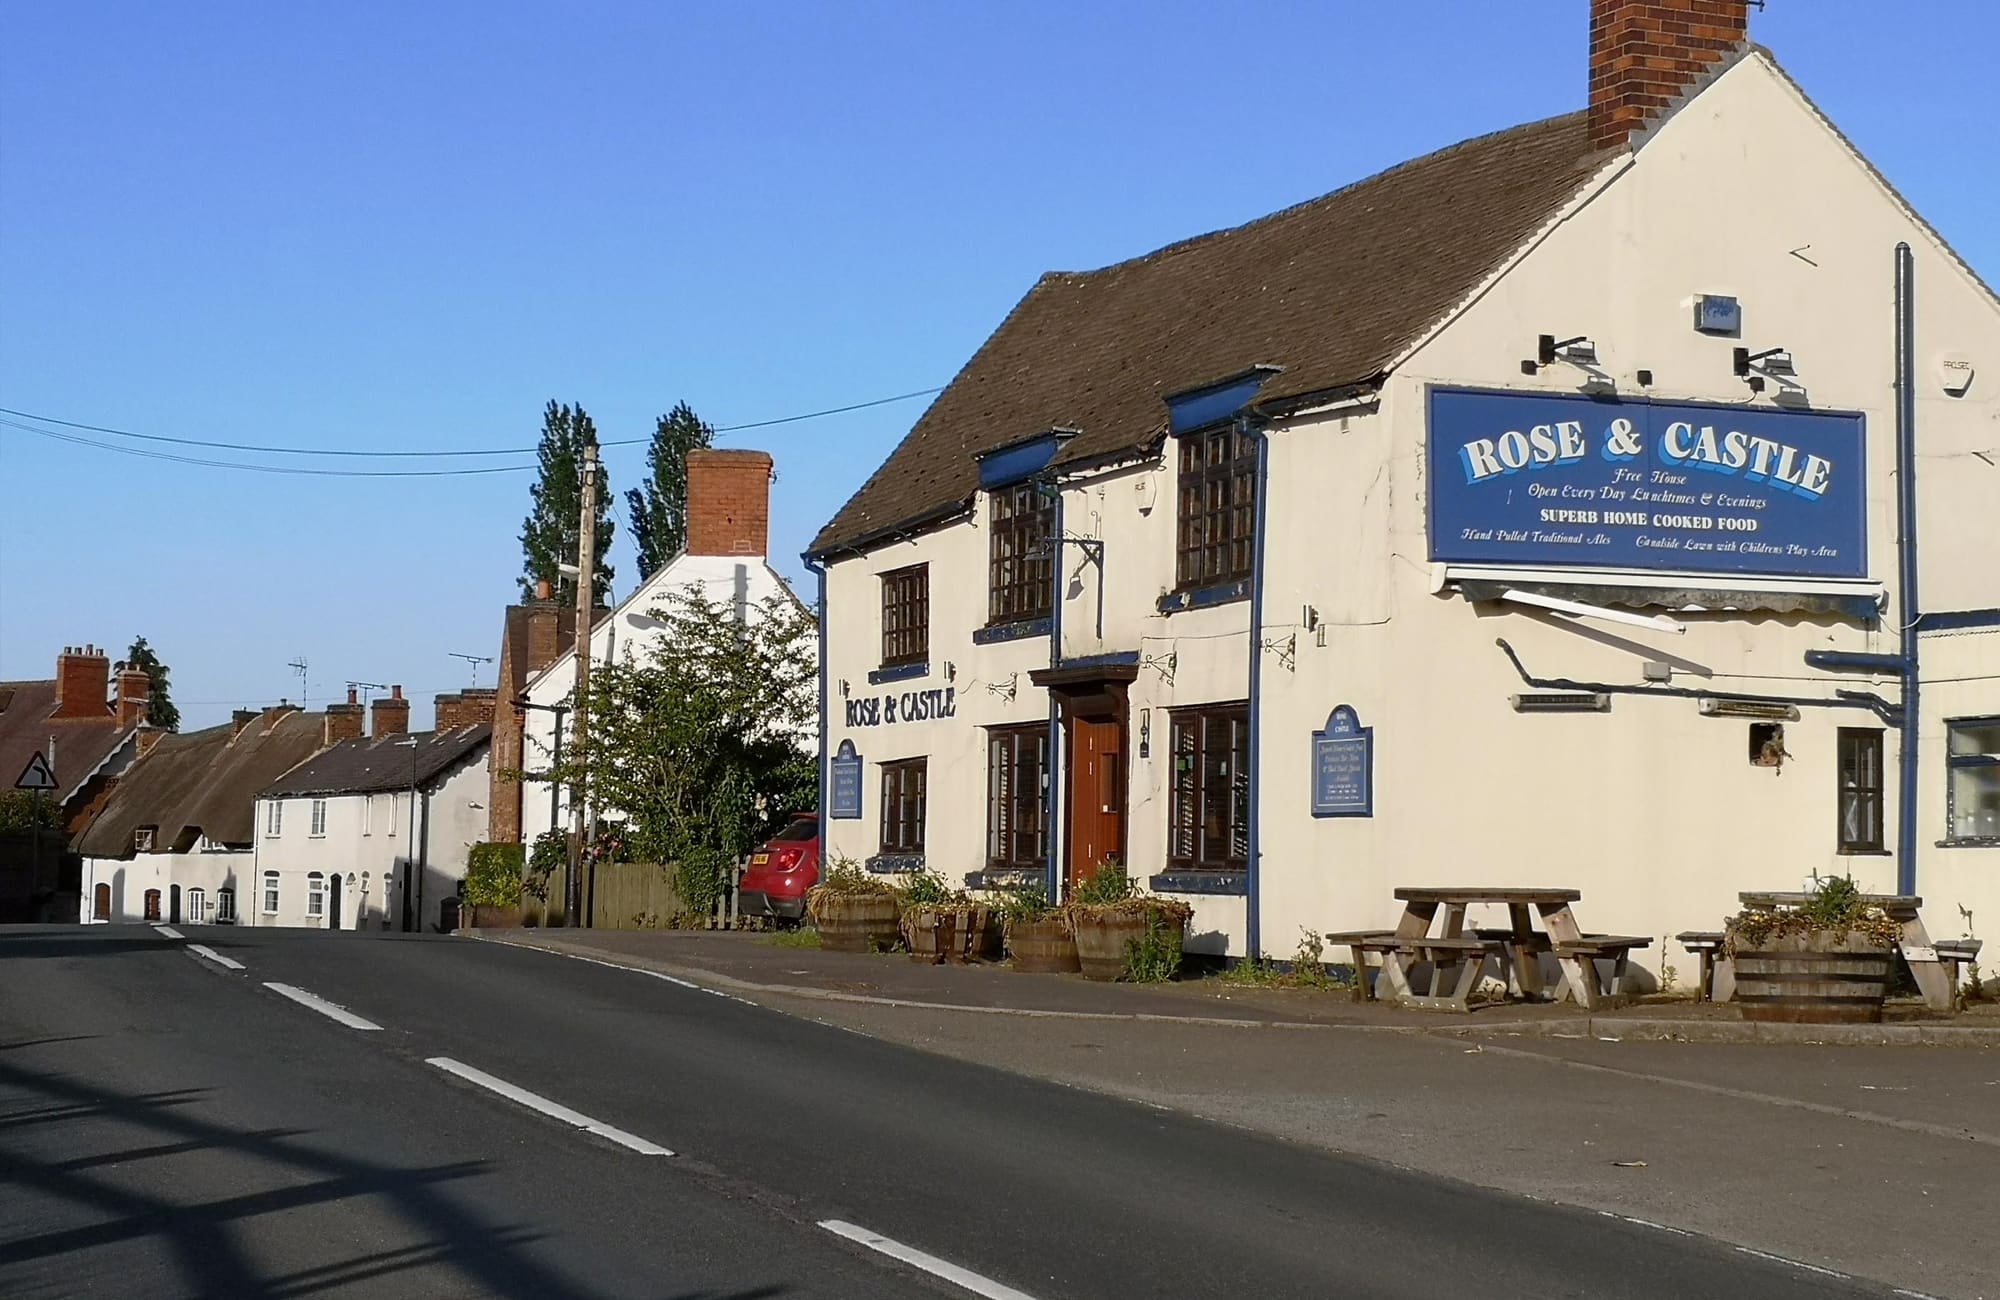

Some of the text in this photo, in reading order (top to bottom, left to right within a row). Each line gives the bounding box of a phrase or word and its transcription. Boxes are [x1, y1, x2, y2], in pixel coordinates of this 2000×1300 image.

[1463, 418, 1832, 495] ROSE & CASTLE
[1612, 469, 1687, 485] Free House
[1528, 483, 1767, 509] Open Every Day Lunchtimes & Evenings
[1540, 508, 1757, 531] SUPERB HOME COOKED FOOD
[1460, 528, 1611, 545] Hand Pulled Traditional Ales
[1635, 535, 1680, 549] Canalside
[1683, 539, 1713, 551] Lawn
[1716, 540, 1736, 552] with
[1786, 544, 1808, 557] Play
[1810, 545, 1837, 557] Area
[845, 687, 956, 727] ROSE & CASTLE
